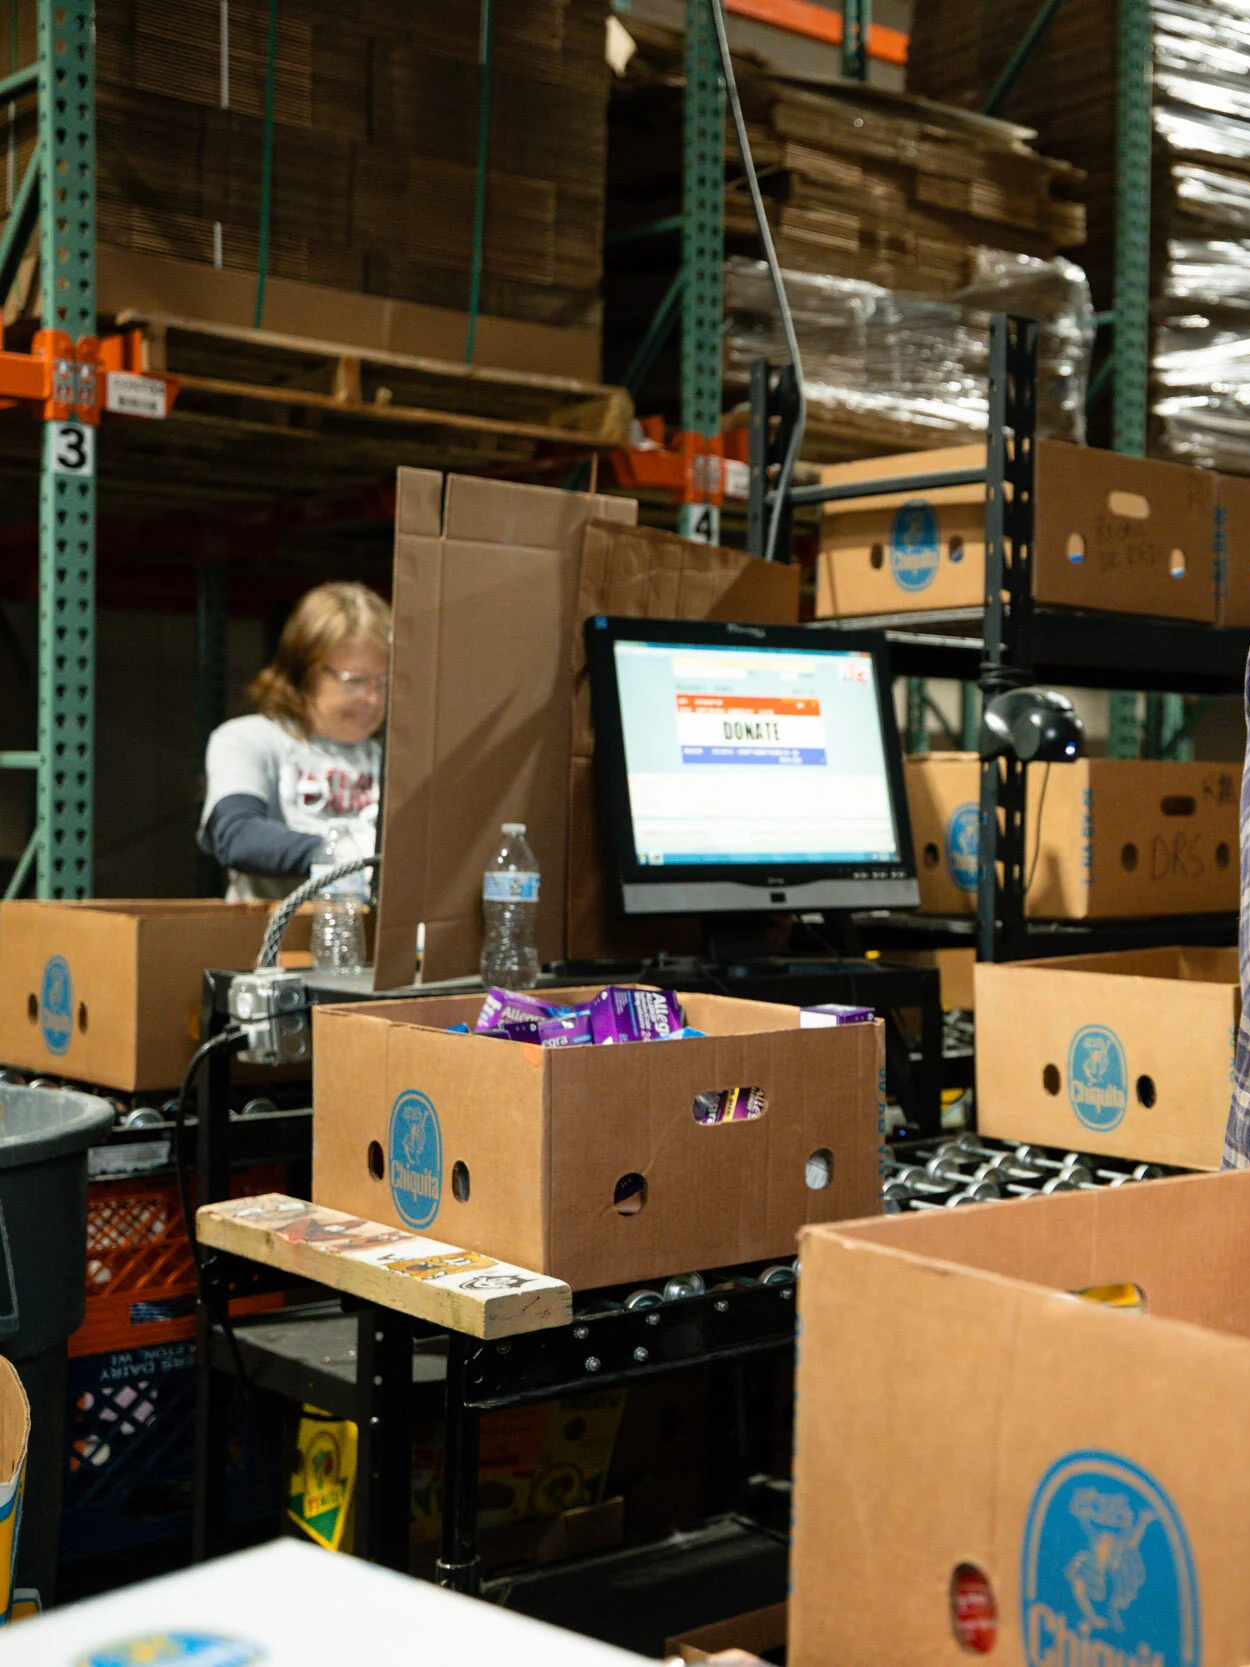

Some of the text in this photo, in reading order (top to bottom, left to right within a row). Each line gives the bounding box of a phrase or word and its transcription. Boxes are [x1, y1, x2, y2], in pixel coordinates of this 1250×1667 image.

[57, 427, 86, 469] 3
[695, 507, 712, 542] 4
[723, 721, 780, 741] DONATE
[651, 991, 671, 1037] Alleg
[1071, 1079, 1125, 1114] Chiquita
[391, 1160, 439, 1202] Chiquita
[99, 1360, 156, 1381] DAIRY
